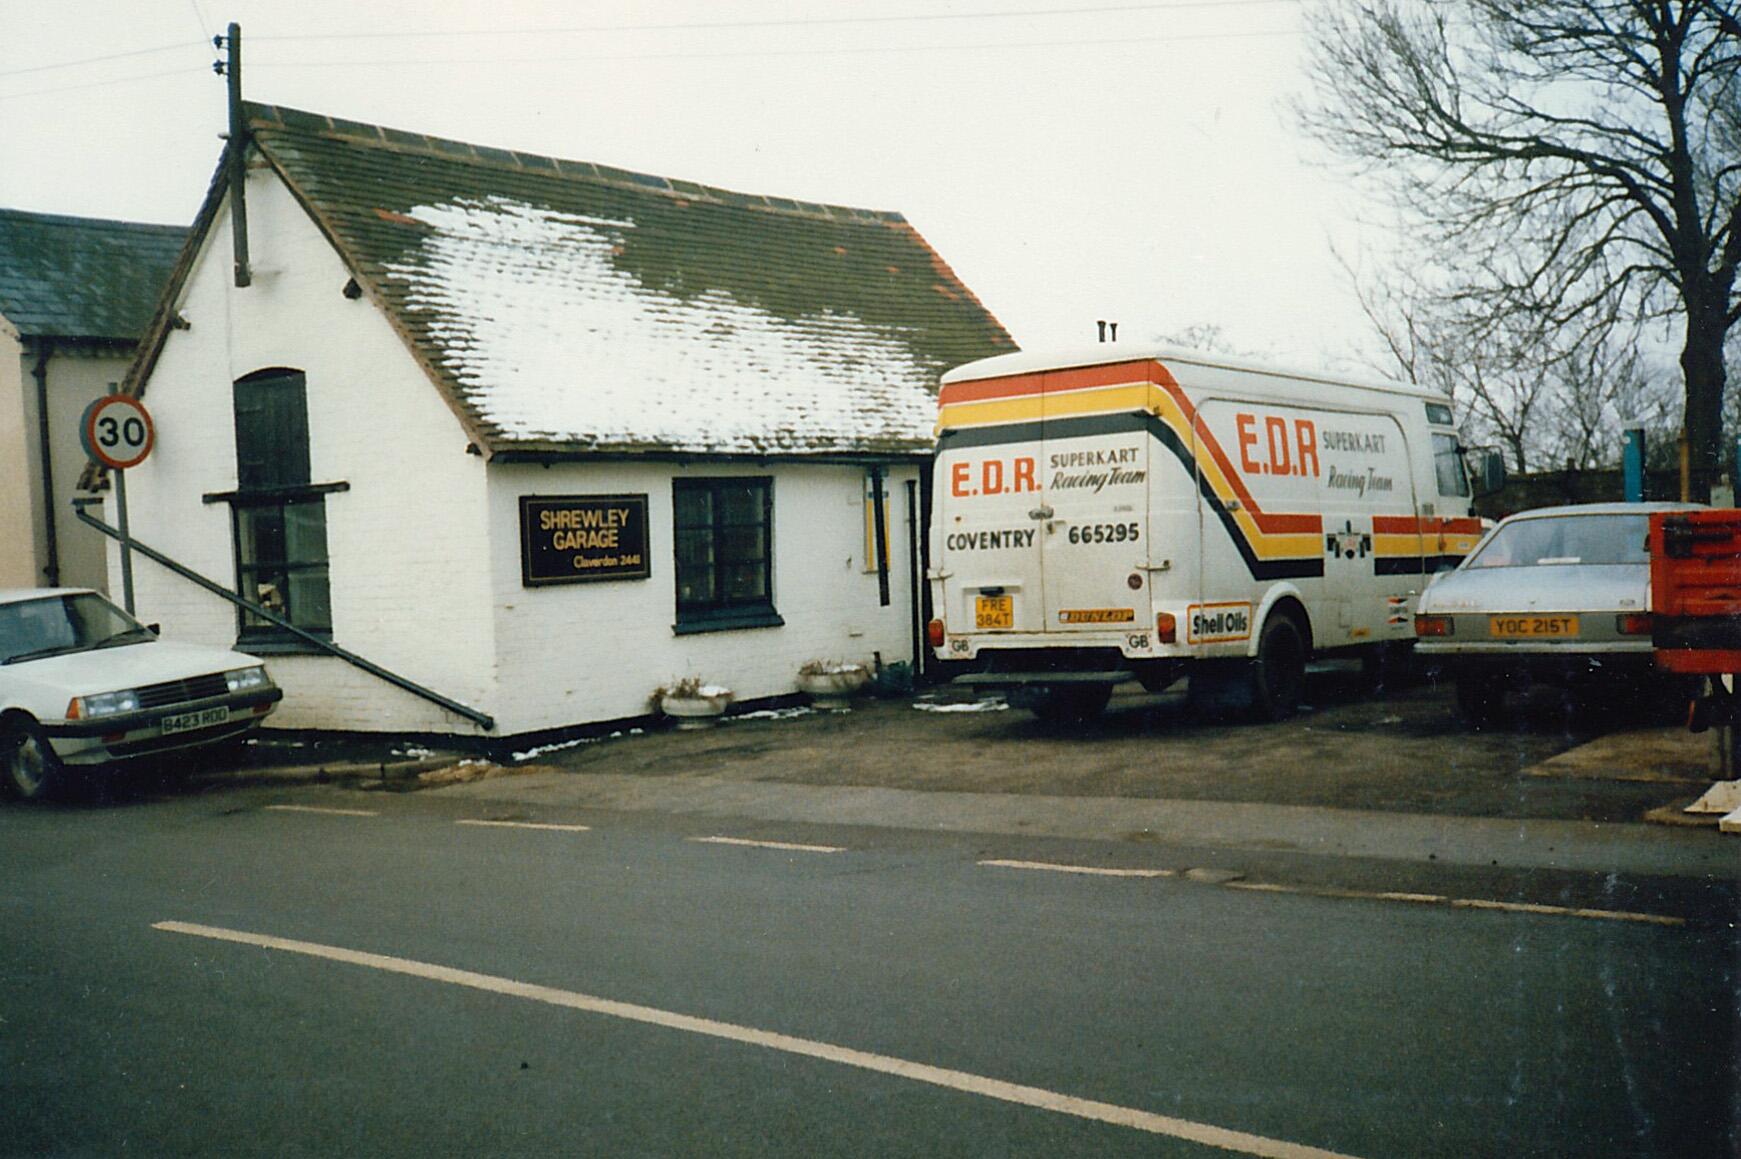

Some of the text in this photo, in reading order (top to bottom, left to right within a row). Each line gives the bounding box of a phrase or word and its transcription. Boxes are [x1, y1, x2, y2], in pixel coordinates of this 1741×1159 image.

[99, 417, 145, 447] 30
[1322, 431, 1385, 453] SUPERKART
[1050, 447, 1139, 469] SUPERKART
[951, 457, 1042, 497] E.D.R.
[1050, 466, 1146, 494] Racing Team
[1328, 465, 1393, 498] Racing Team
[540, 508, 630, 530] SHREWLEY
[553, 529, 618, 550] GARAGE
[947, 528, 1036, 551] COVENTRY
[1068, 522, 1140, 545] 665295
[573, 555, 618, 569] Claverdon
[982, 598, 1007, 612] FRE
[1193, 612, 1248, 636] Shell Oils
[1495, 618, 1572, 634] YOC 215T
[951, 639, 969, 652] GB
[1128, 634, 1149, 649] GB
[164, 713, 199, 731] B423
